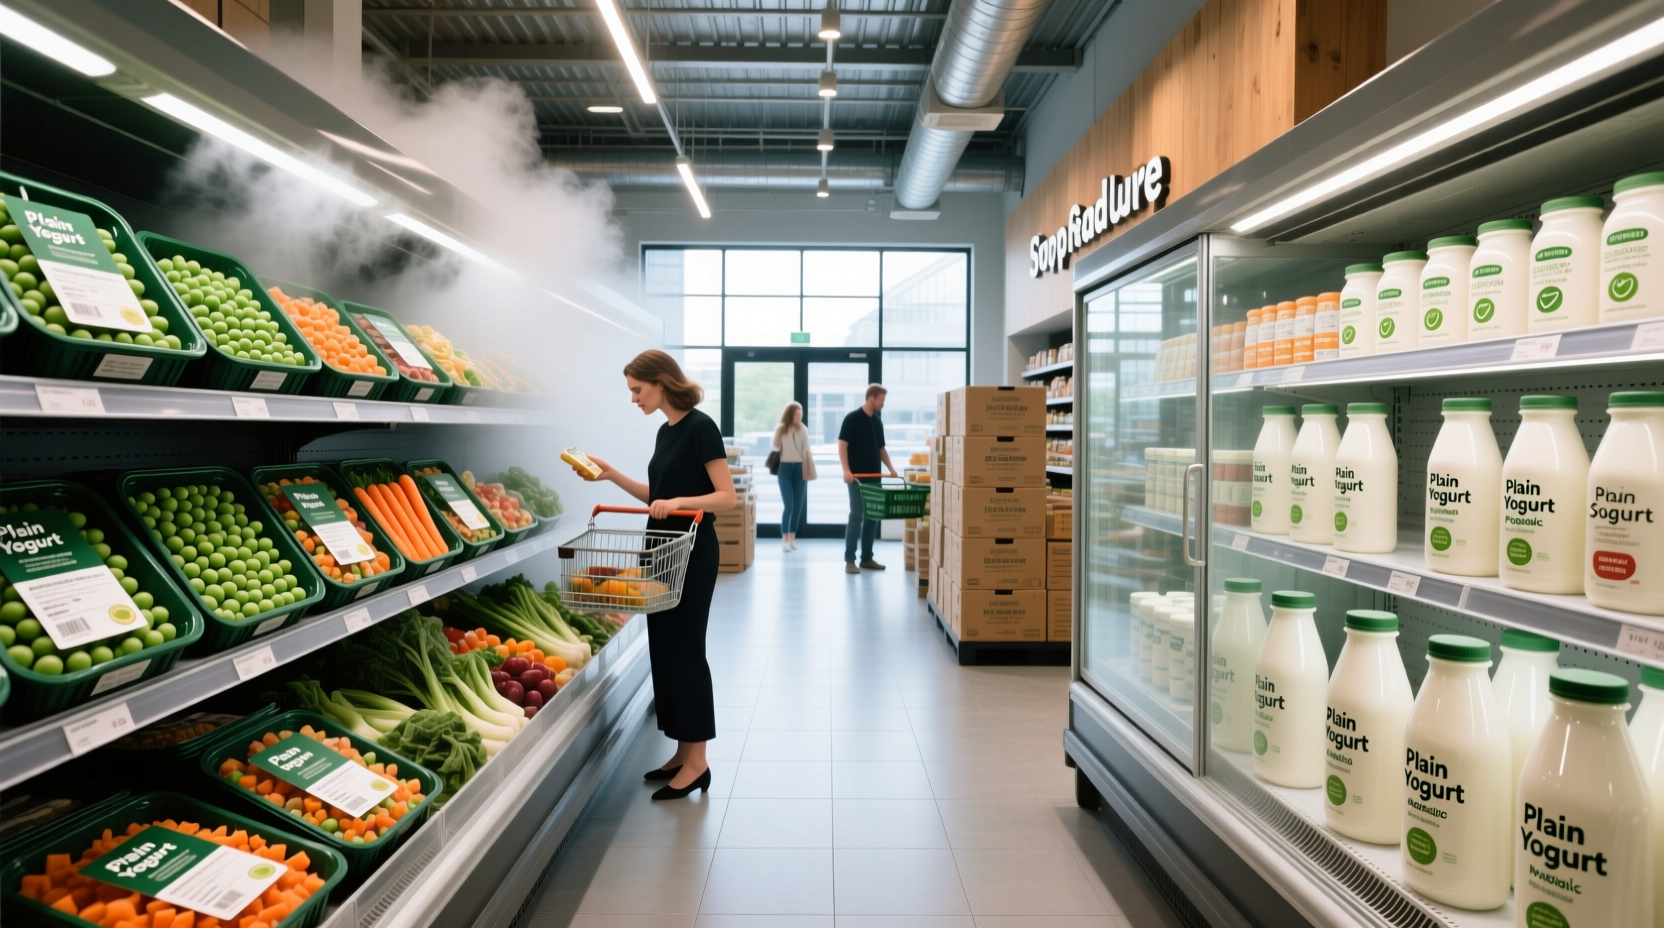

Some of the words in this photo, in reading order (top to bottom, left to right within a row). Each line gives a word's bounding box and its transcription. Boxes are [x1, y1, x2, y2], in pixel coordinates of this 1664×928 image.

[24, 210, 74, 232] Plain
[28, 223, 86, 245] Yogurt
[1430, 473, 1459, 488] Plain
[1506, 479, 1541, 496] Plain
[1429, 487, 1471, 506] Yogurt
[1504, 495, 1555, 515] Yogurt
[1589, 502, 1653, 525] Sogurt
[0, 521, 45, 540] Plain
[0, 533, 64, 555] Yogurt
[1327, 706, 1356, 732] Plain
[1326, 724, 1369, 752] Yogurt
[1406, 747, 1448, 779] Plain
[1404, 767, 1464, 804] Yogurt
[1524, 802, 1585, 846] Plain
[1520, 825, 1608, 876] Yogurt
